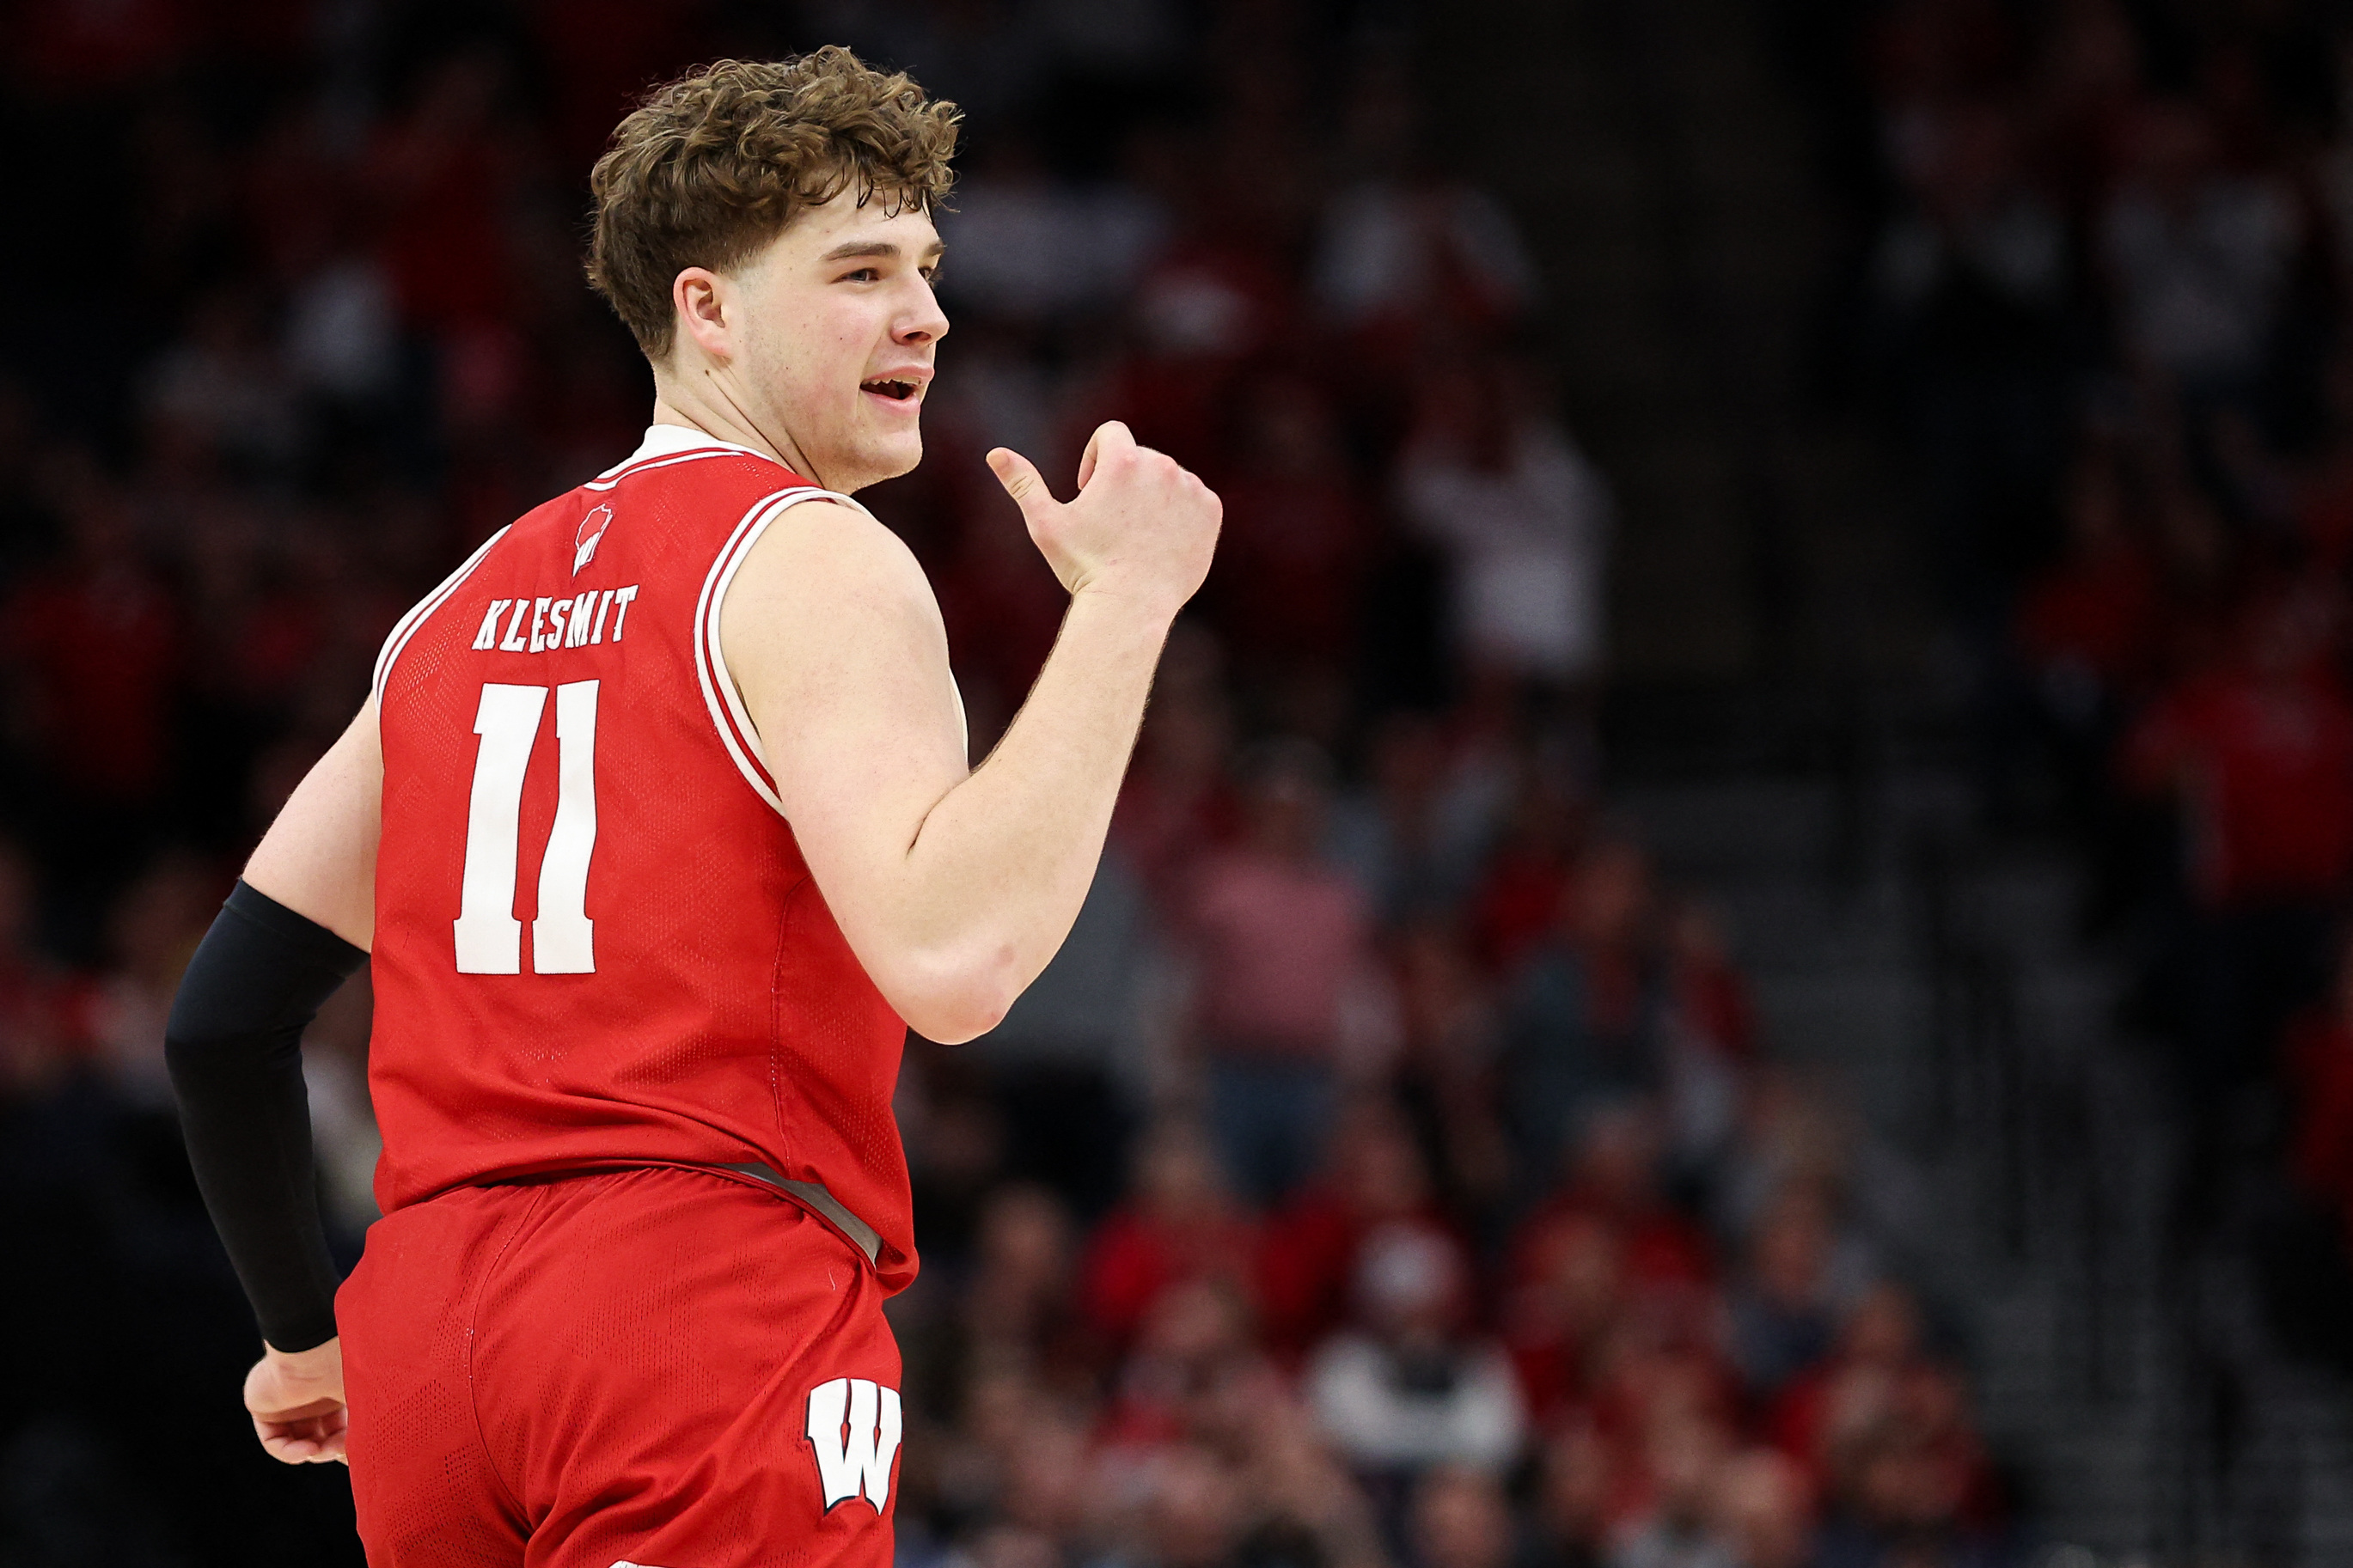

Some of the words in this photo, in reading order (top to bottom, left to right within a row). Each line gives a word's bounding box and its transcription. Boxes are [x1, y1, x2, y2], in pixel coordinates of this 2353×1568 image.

[471, 584, 639, 653] KLESMIT
[453, 679, 600, 974] 11
[804, 1377, 902, 1516] W
